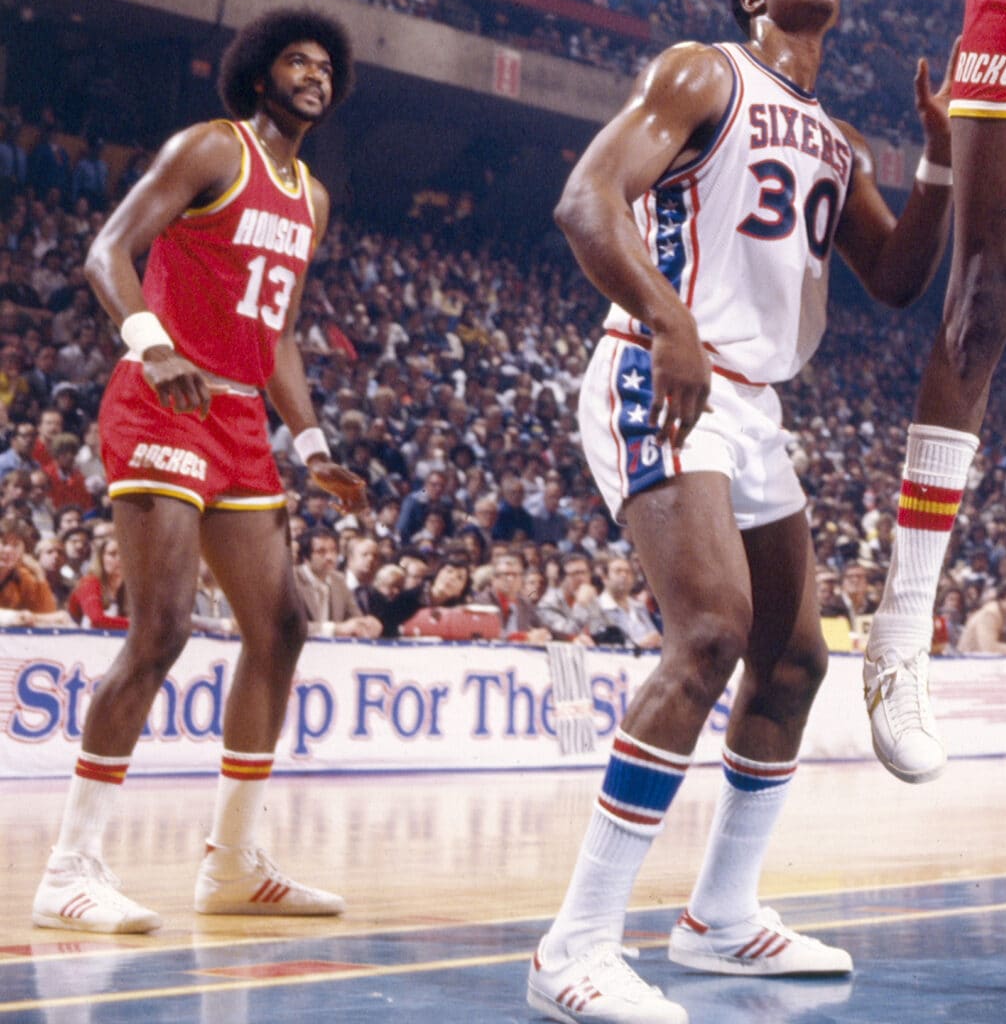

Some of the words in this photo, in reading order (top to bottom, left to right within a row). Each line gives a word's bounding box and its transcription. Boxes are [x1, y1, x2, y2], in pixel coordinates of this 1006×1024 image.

[748, 103, 852, 187] SIXERS
[736, 158, 841, 261] 30
[236, 254, 297, 332] 13
[627, 434, 660, 474] 76
[8, 661, 223, 741] Stnd
[352, 671, 450, 739] For
